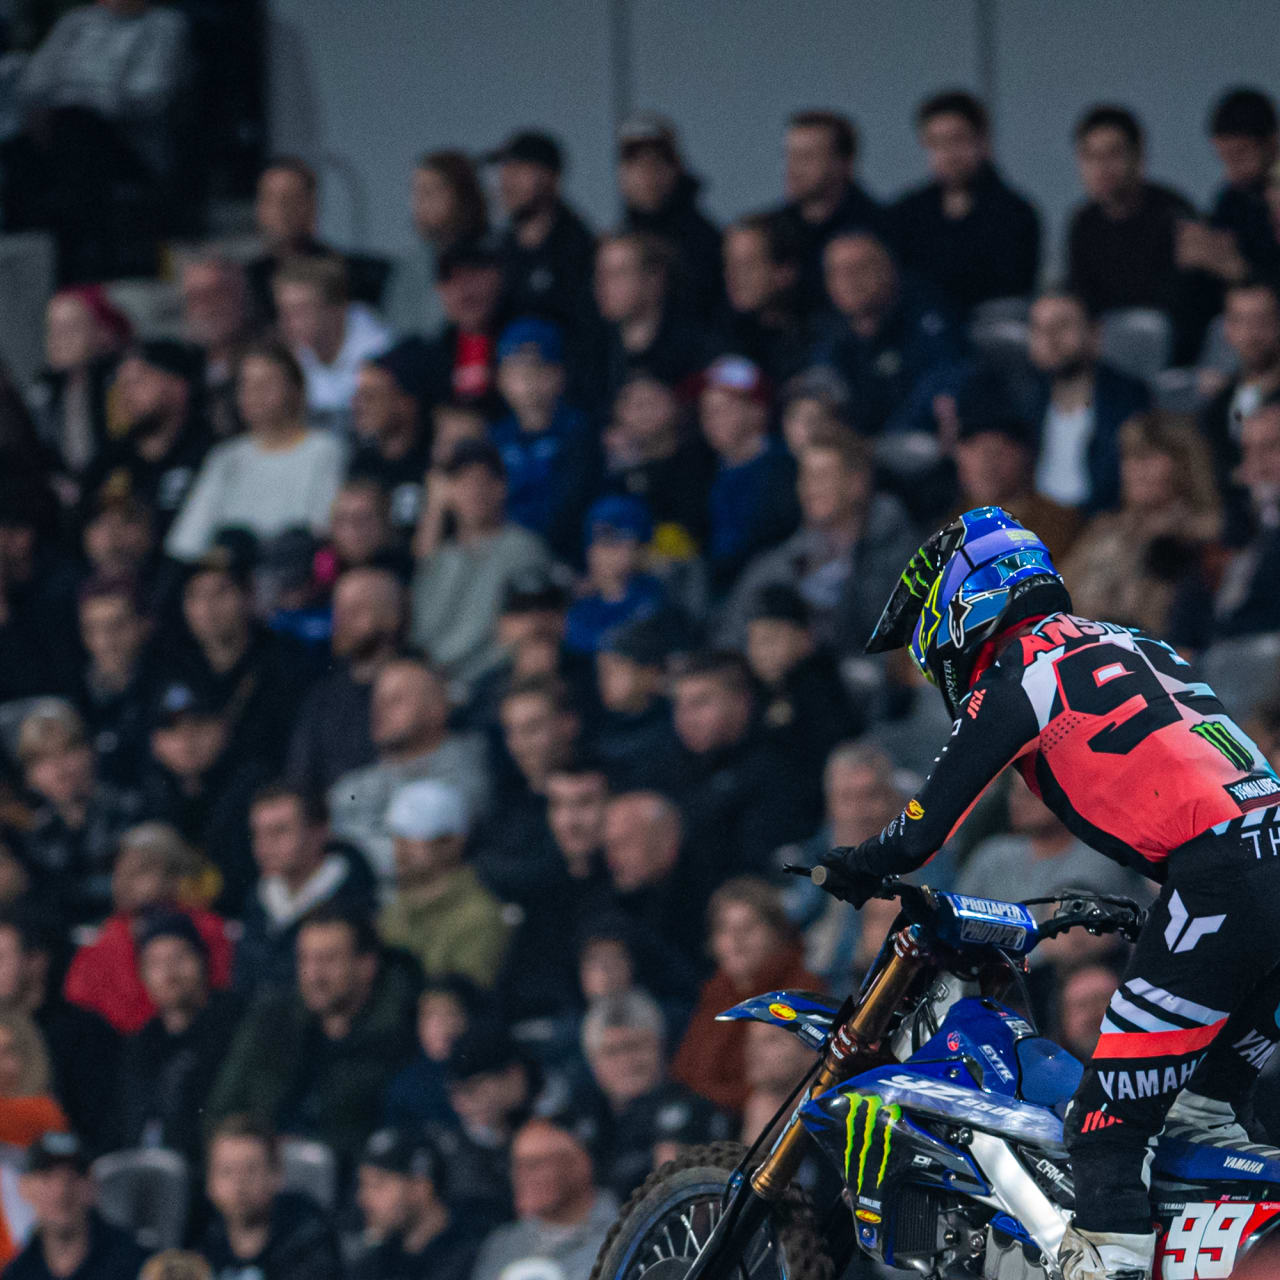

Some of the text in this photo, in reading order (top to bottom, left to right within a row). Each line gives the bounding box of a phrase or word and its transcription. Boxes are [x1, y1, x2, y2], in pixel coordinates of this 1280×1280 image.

[1020, 612, 1141, 666] ANS
[956, 893, 1023, 921] PROTAPER
[980, 1043, 1016, 1082] GYTR
[1097, 1052, 1209, 1101] YAMAH
[1223, 1155, 1265, 1175] YAMAHA
[1161, 1202, 1256, 1280] 99
